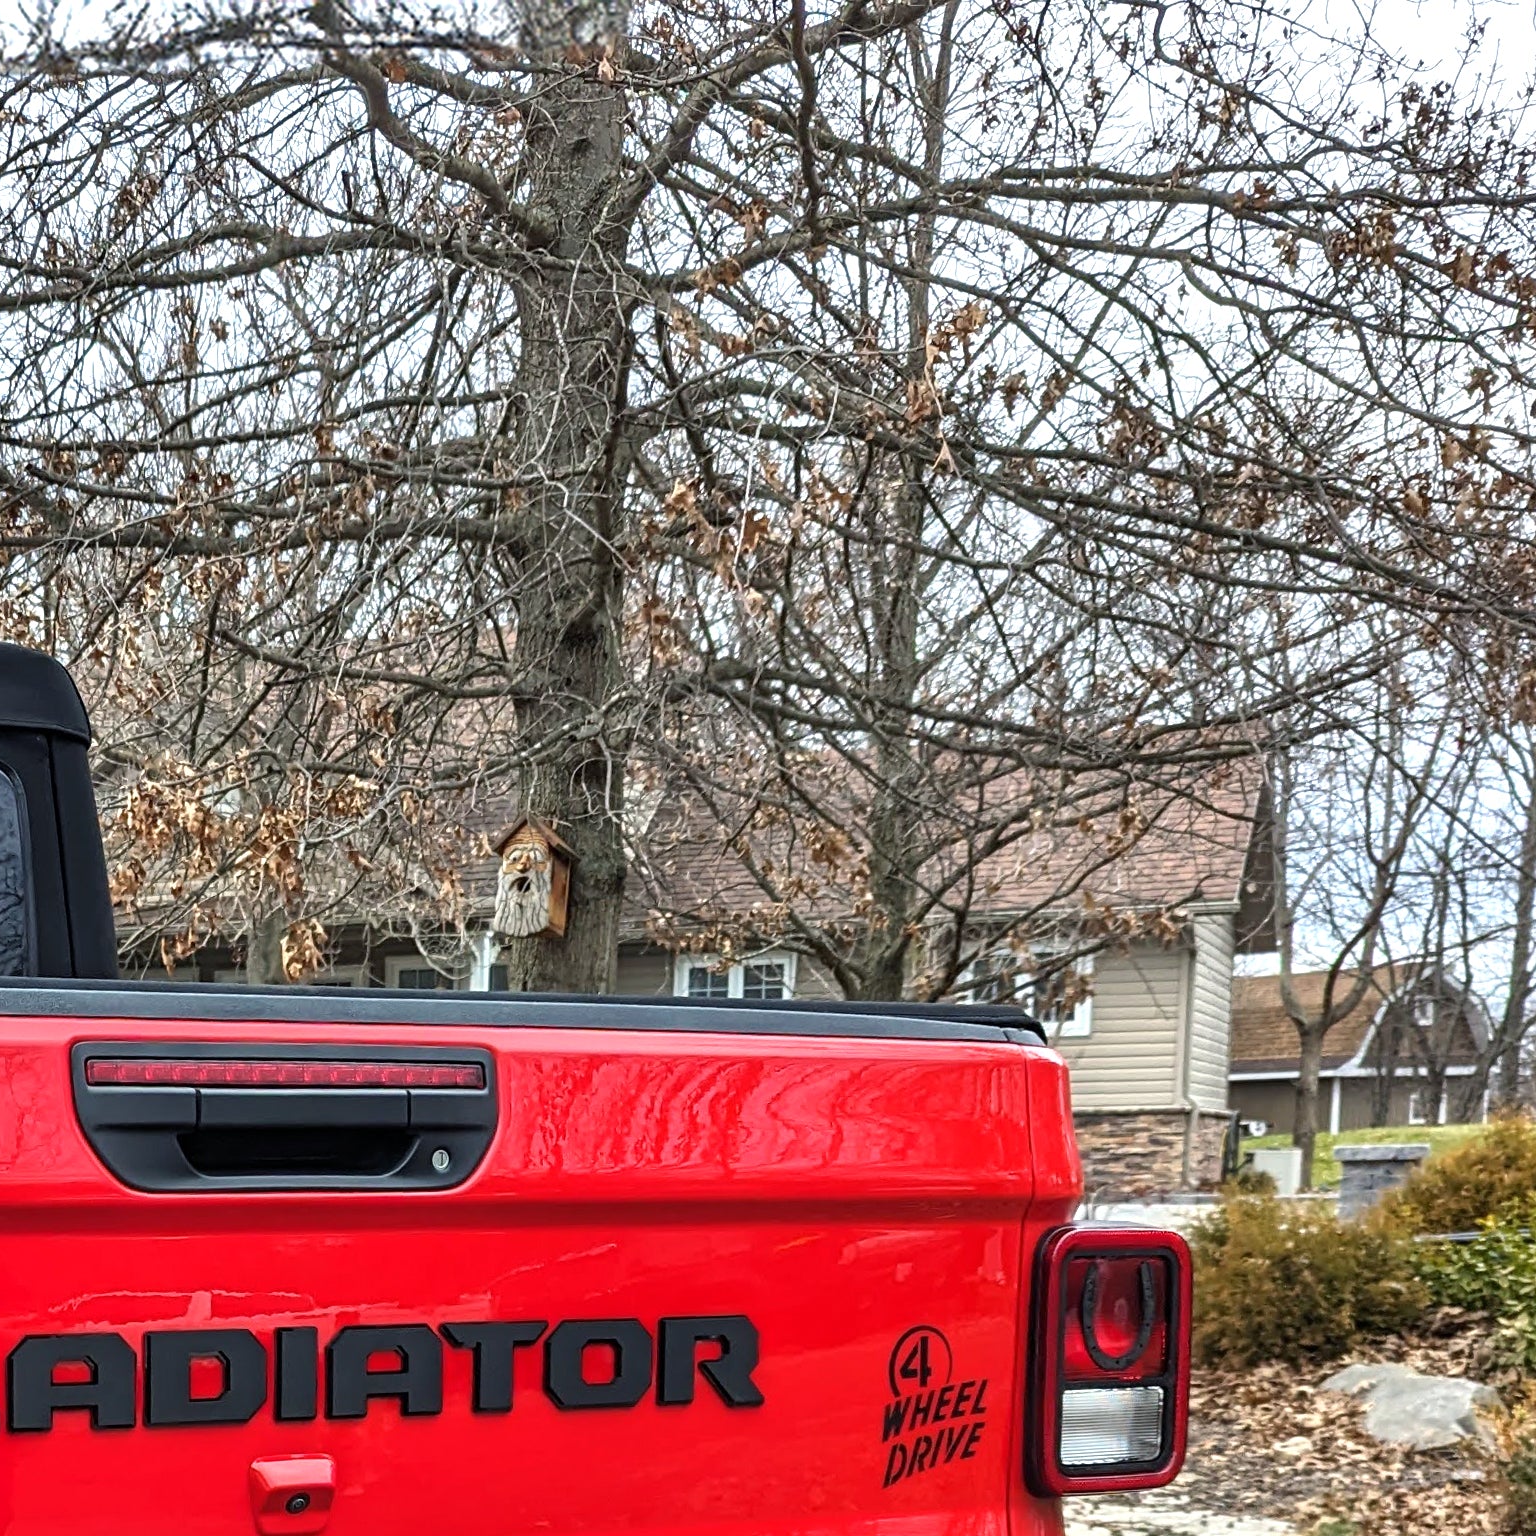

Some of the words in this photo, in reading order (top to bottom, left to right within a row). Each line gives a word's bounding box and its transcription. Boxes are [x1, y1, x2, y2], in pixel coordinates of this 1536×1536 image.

[899, 1336, 932, 1388] 4
[882, 1379, 988, 1443] WHEEL
[882, 1421, 987, 1489] DRIVE
